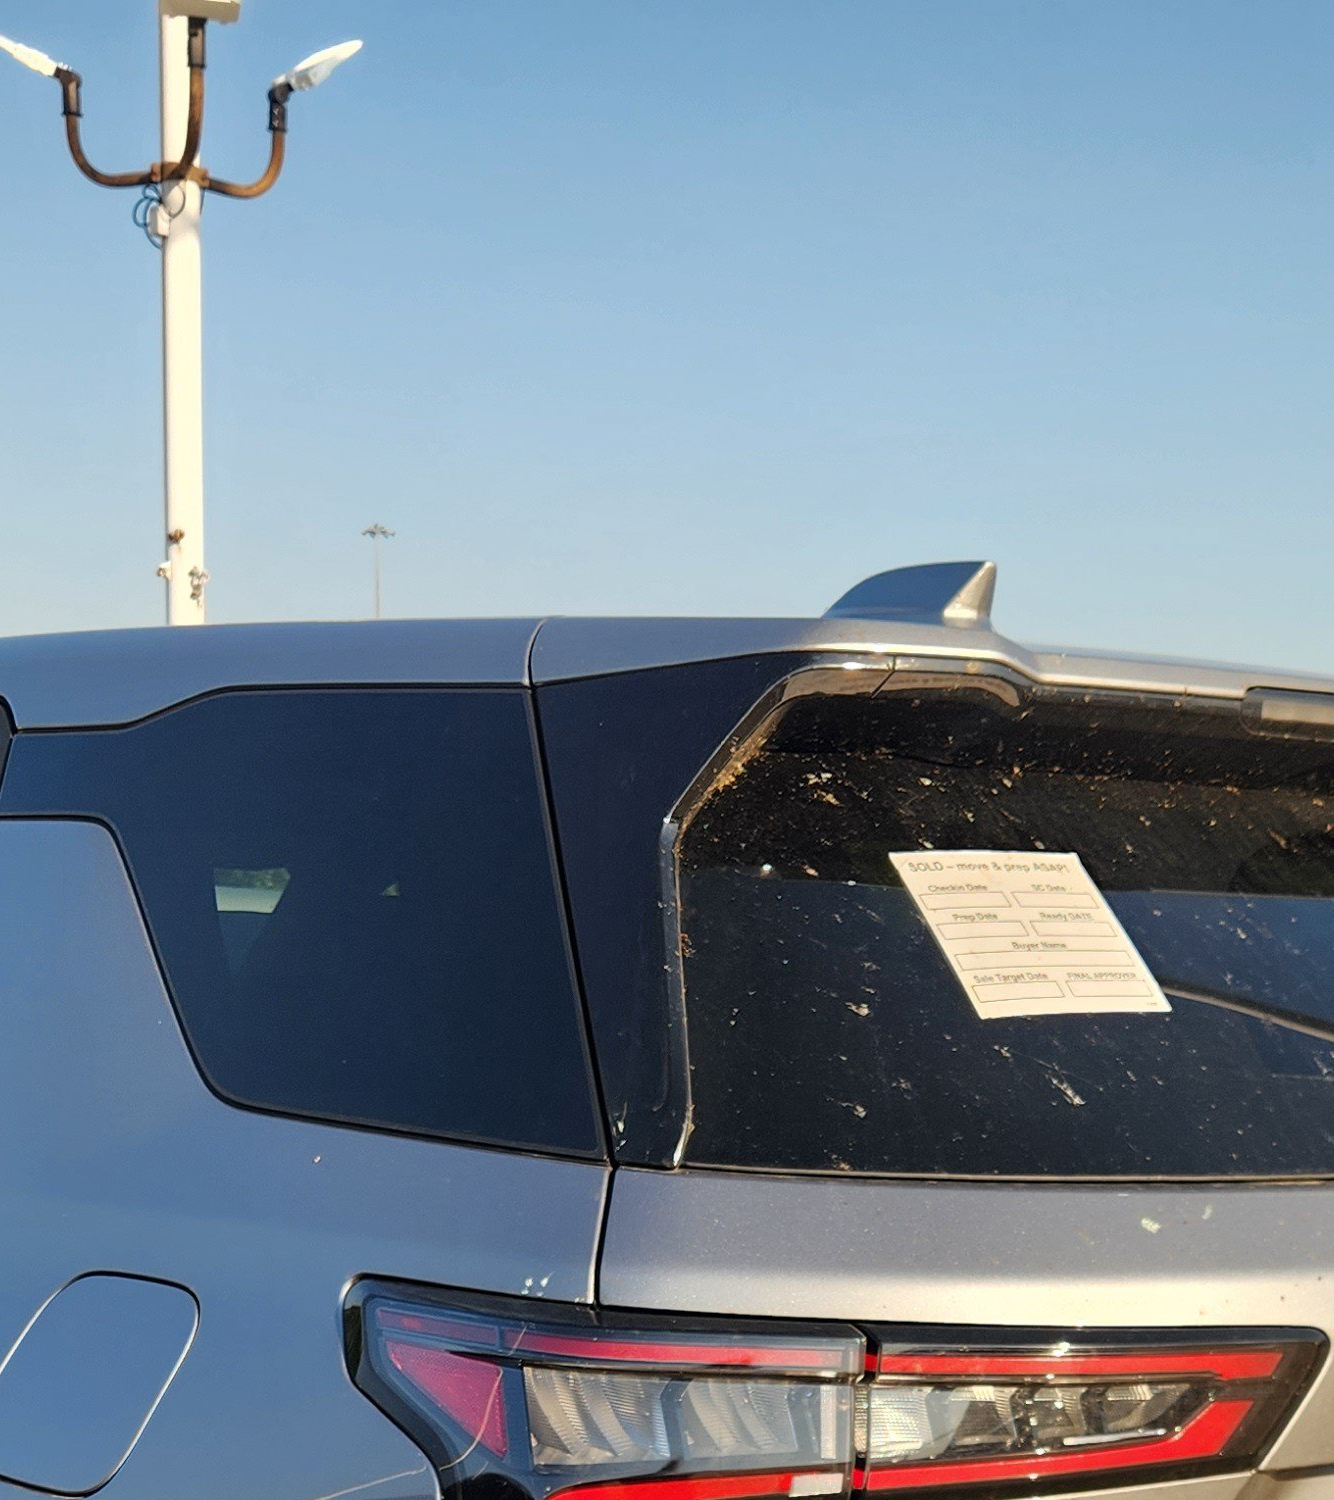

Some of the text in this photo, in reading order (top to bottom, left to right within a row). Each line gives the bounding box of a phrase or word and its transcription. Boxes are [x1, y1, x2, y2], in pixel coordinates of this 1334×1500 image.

[908, 861, 944, 873] SOLD
[957, 863, 989, 872] move
[992, 861, 1002, 872] &
[1004, 863, 1031, 873] prep
[928, 884, 988, 893] Checkin Date
[952, 912, 998, 922] Prep Date
[1039, 912, 1094, 922] Ready DATE
[1011, 941, 1067, 952] Buyer Name
[973, 972, 1048, 984] Sale Target Date
